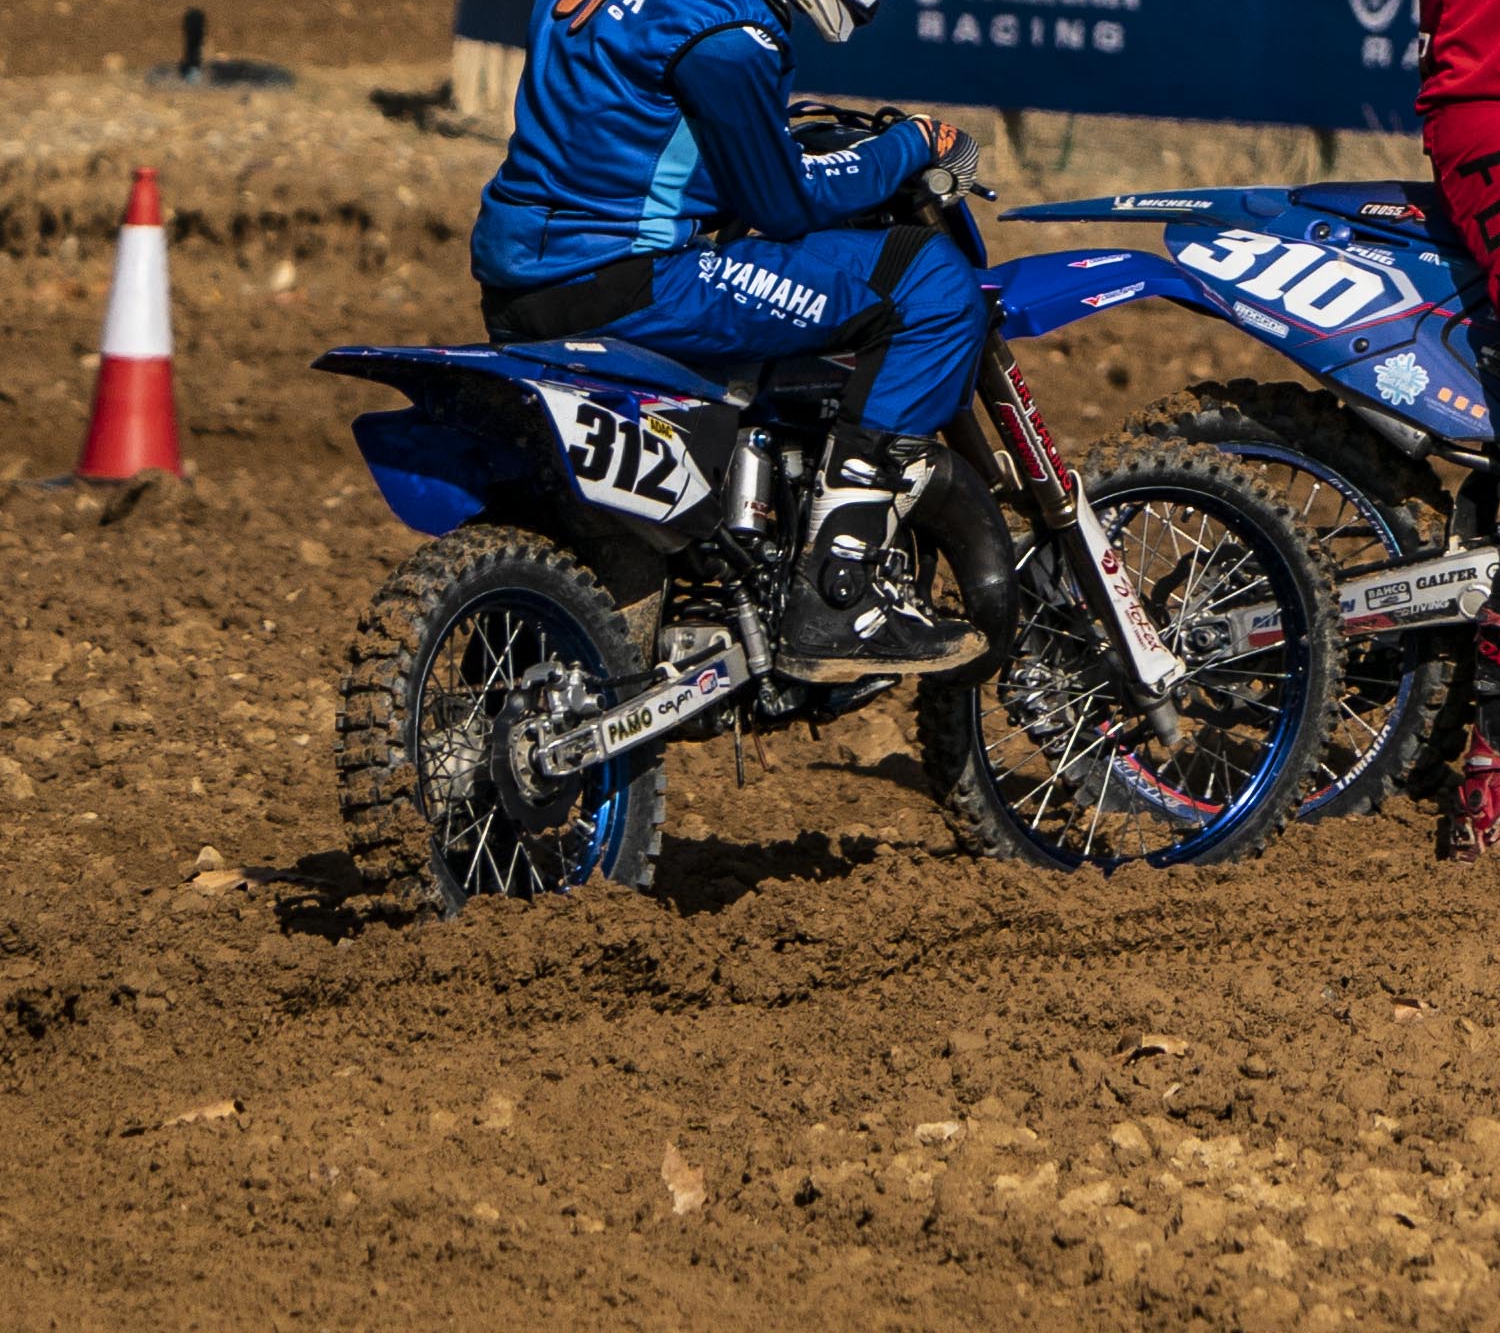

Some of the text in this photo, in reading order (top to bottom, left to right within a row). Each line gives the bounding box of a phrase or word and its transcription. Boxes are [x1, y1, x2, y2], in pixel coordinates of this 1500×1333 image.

[916, 9, 1126, 54] RACING
[1137, 198, 1213, 210] MICHELIN
[698, 270, 808, 329] RACING
[721, 256, 829, 325] YAMAHA
[1176, 228, 1385, 329] 310
[649, 418, 674, 438] ADAC
[568, 403, 679, 507] 312
[1368, 583, 1409, 599] BAHCO
[1415, 567, 1479, 590] GALFER
[608, 706, 653, 745] PAMO
